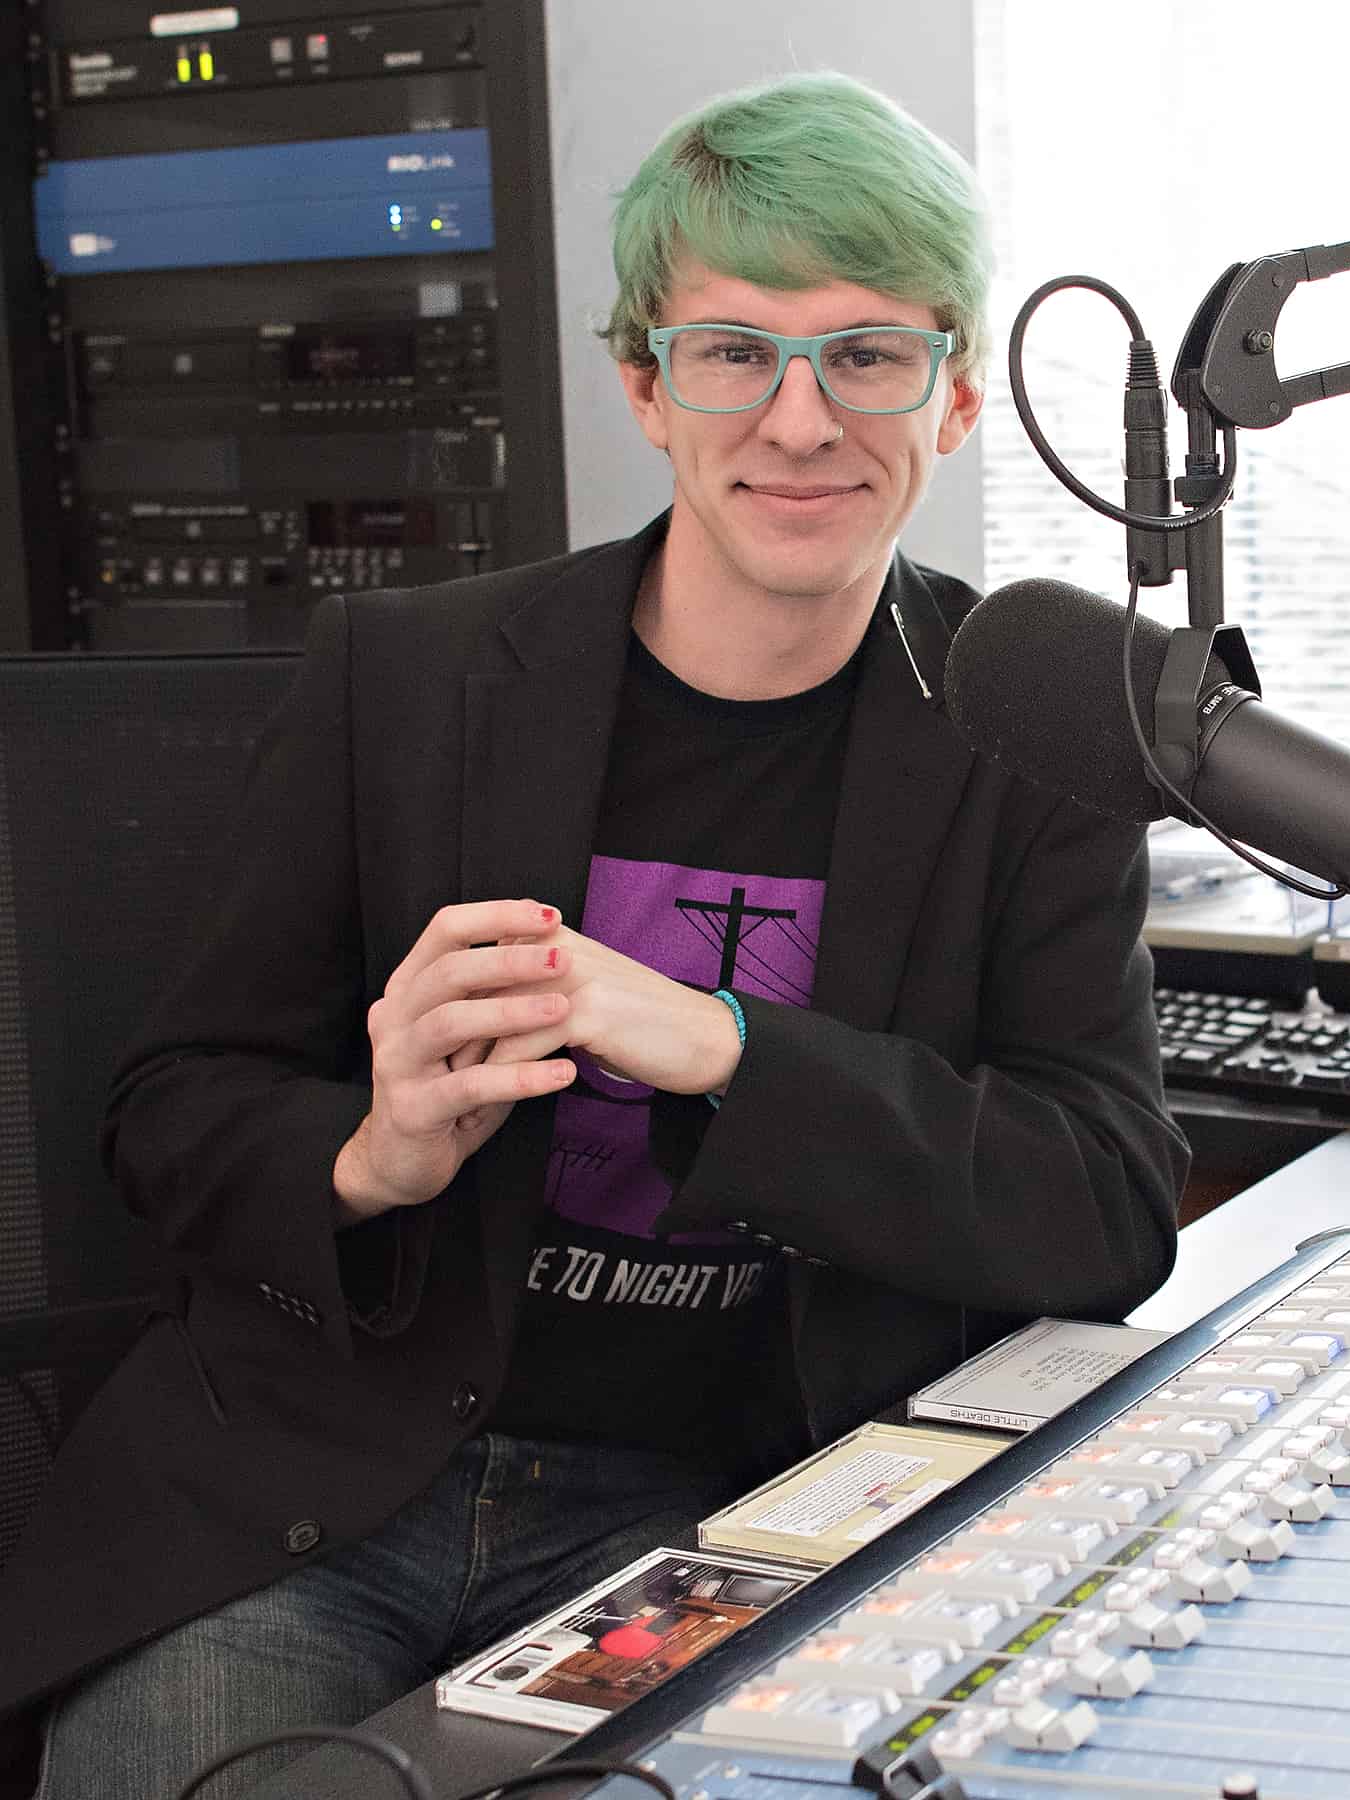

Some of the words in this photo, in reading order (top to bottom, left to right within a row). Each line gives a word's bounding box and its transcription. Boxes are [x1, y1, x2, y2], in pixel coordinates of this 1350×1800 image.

[527, 1246, 557, 1291] E
[552, 1245, 605, 1301] TO
[603, 1258, 719, 1309] NIGHT
[950, 1408, 992, 1424] DEATHS
[993, 1415, 1029, 1429] LITTLE
